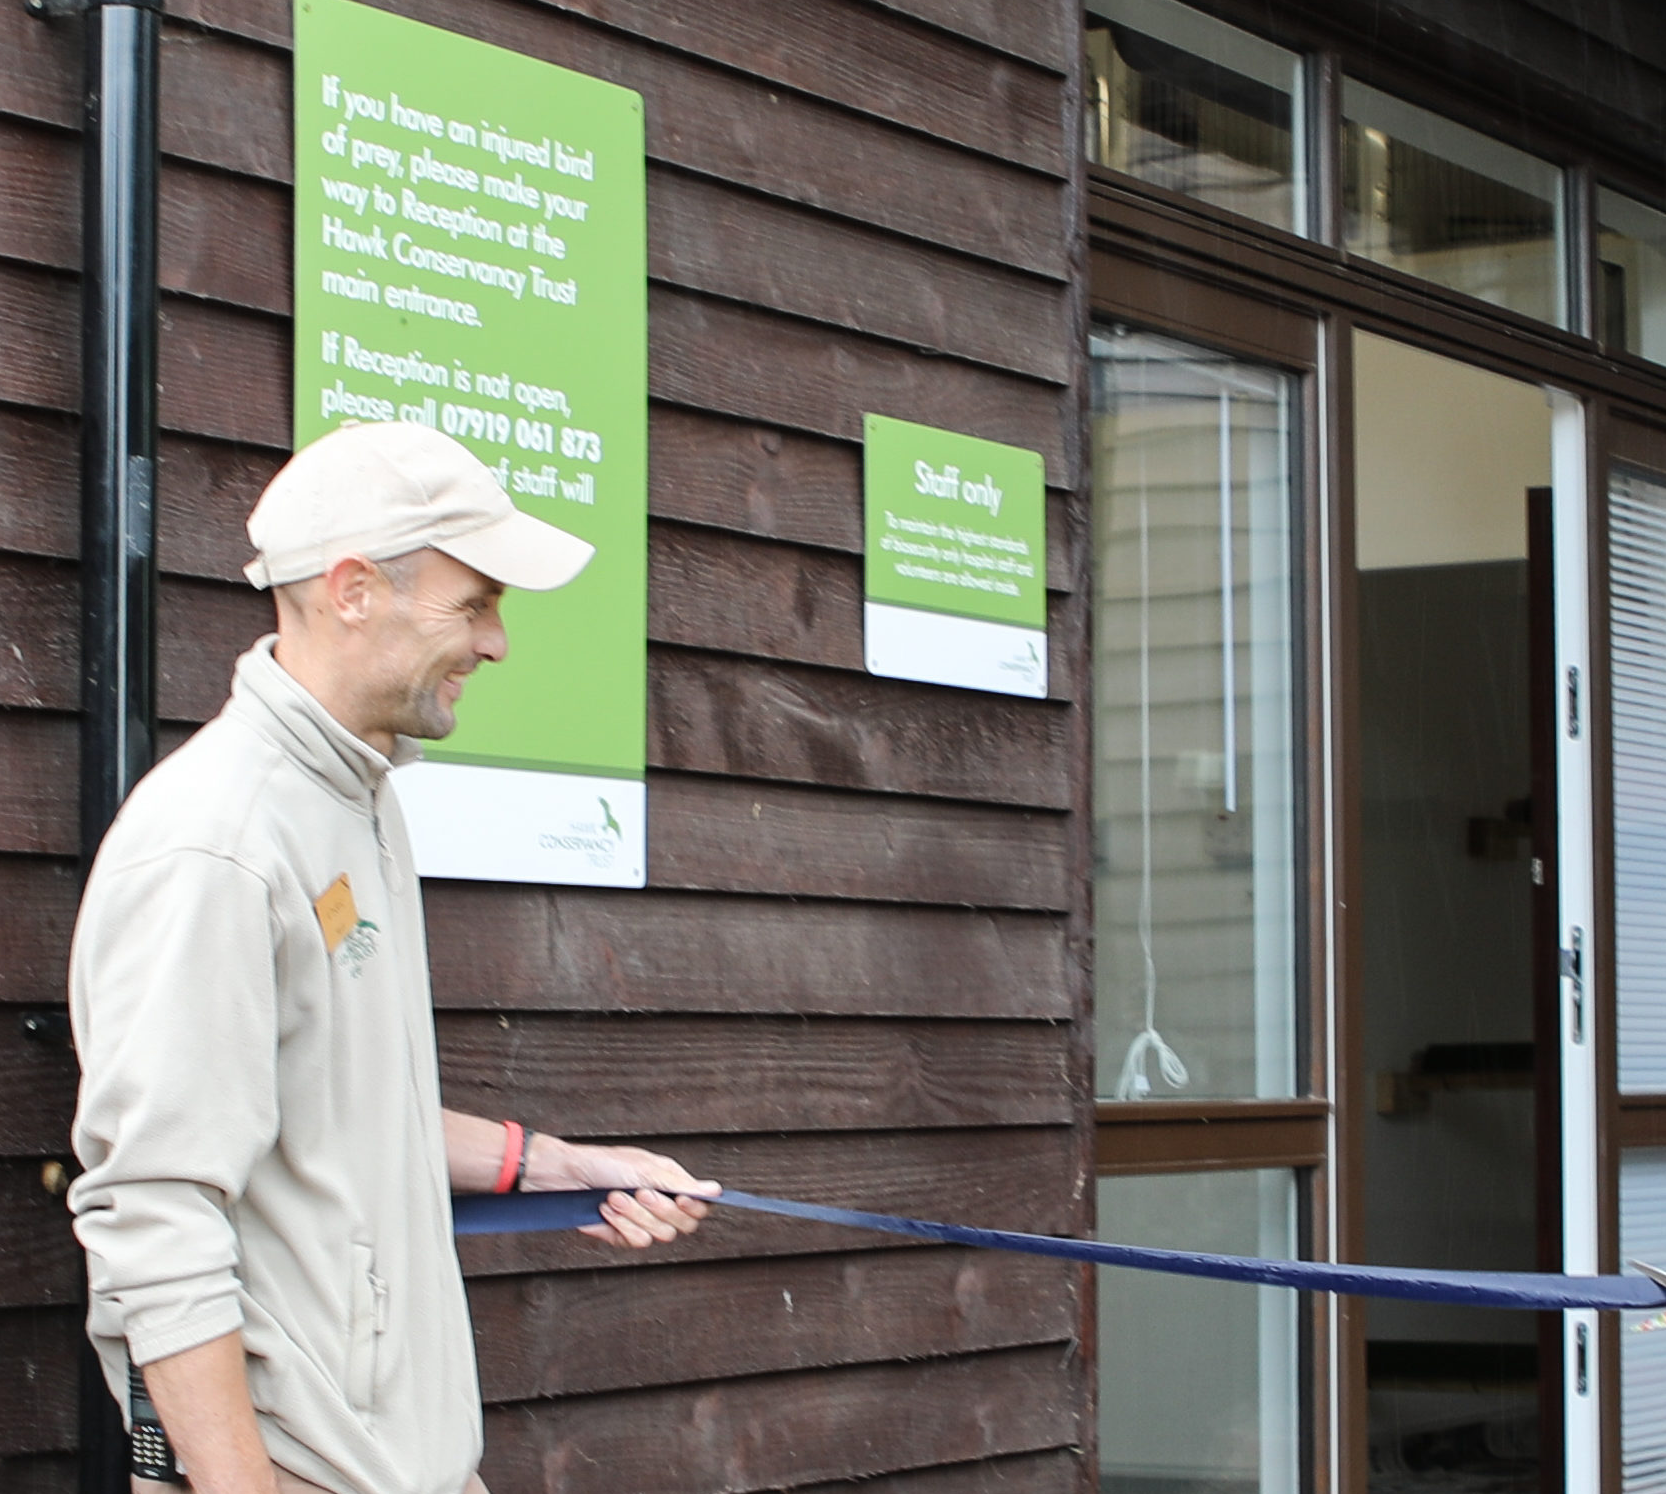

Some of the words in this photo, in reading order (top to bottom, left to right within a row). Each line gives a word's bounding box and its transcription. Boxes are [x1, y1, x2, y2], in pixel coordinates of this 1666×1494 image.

[322, 73, 341, 108] If
[343, 89, 385, 121] you
[390, 91, 445, 138] have
[448, 119, 477, 148] an
[481, 119, 551, 169] injured
[554, 139, 594, 182] bird
[321, 122, 349, 157] of
[351, 138, 405, 179] prey,
[410, 146, 480, 193] please
[483, 172, 540, 209] make
[543, 190, 589, 222] your
[320, 176, 370, 217] way
[371, 183, 397, 216] to
[401, 187, 503, 244] Reception
[506, 222, 529, 250] at
[531, 222, 566, 260] the
[321, 213, 389, 260] Hawk
[393, 232, 527, 300] Conservancy
[529, 265, 578, 306] Trust
[321, 268, 380, 304] main
[384, 284, 483, 328] entrance.
[321, 330, 340, 365] If
[344, 335, 448, 388] Reception
[453, 359, 471, 393] is
[476, 372, 510, 401] not
[515, 381, 571, 419] open,
[321, 379, 395, 422] please
[399, 396, 437, 429] call
[442, 402, 511, 445] 07919
[515, 419, 553, 454] 061
[560, 426, 602, 464] 873
[512, 465, 558, 498] staff
[560, 472, 595, 505] will
[914, 459, 961, 501] Staff
[962, 473, 1003, 518] only
